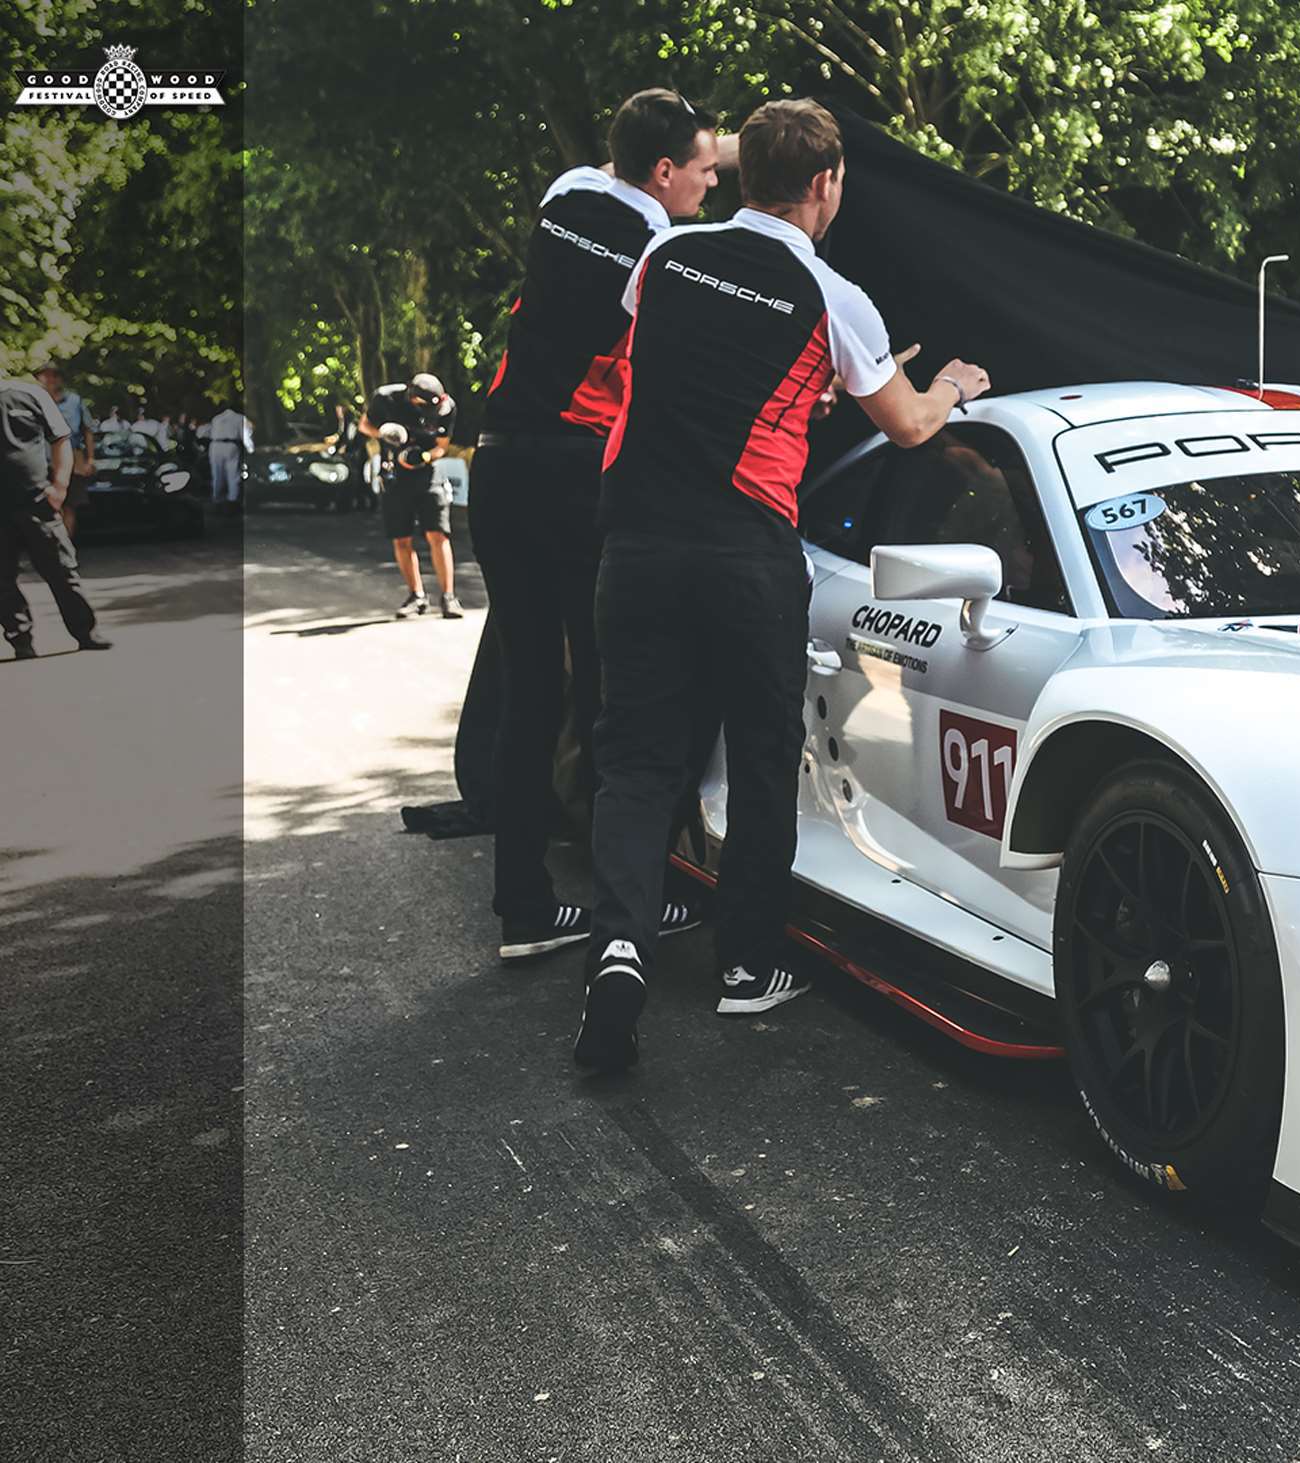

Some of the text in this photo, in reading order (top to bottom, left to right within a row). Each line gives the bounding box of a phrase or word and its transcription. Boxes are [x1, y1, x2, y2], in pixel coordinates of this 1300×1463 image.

[540, 218, 636, 268] PORSCHE
[665, 260, 794, 314] PORSCHE
[1101, 498, 1146, 524] 567
[852, 605, 942, 648] CHOPARD
[944, 728, 1013, 821] 911
